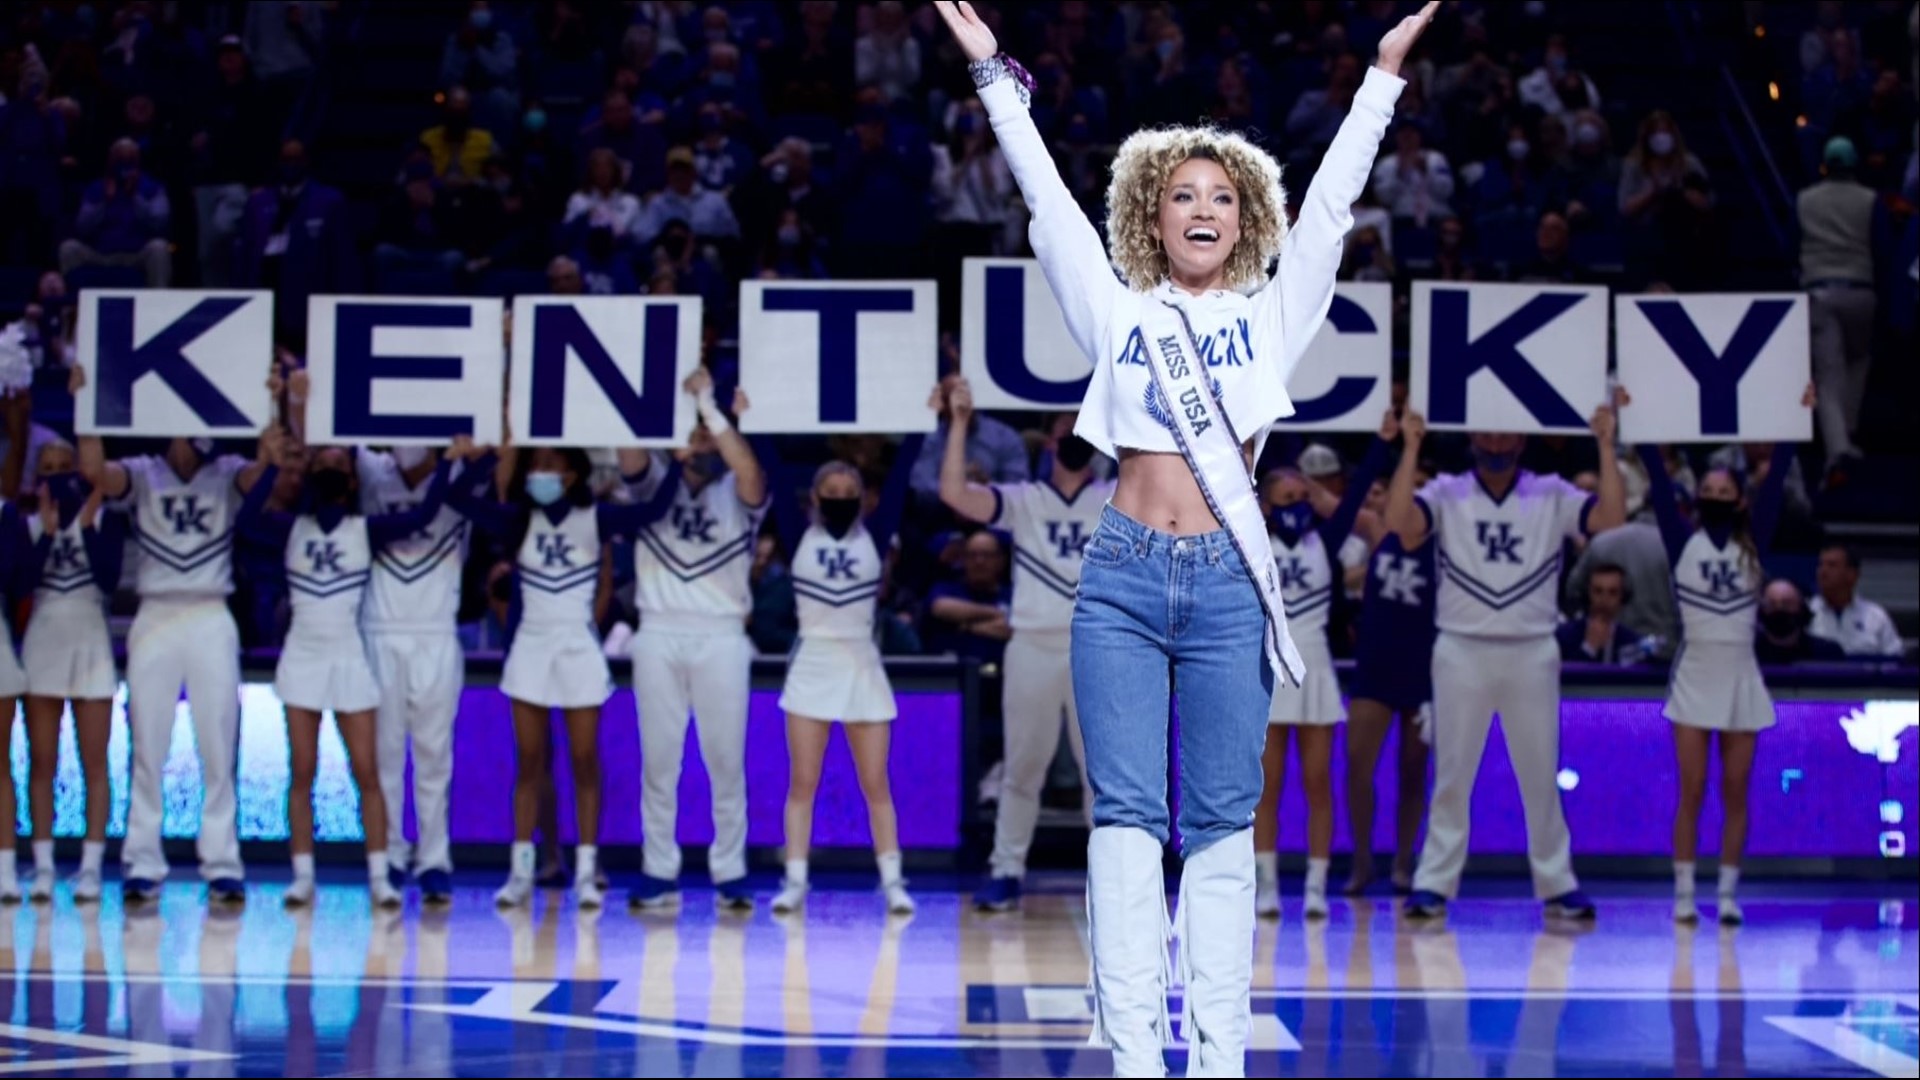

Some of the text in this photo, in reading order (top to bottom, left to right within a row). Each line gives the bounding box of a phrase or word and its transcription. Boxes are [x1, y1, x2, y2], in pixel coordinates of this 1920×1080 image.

[94, 297, 254, 428] K
[332, 302, 475, 437] E
[529, 303, 679, 438] N
[761, 287, 915, 424] T
[1157, 334, 1213, 437] MISS USA
[1426, 287, 1588, 428] K
[1634, 299, 1795, 436] Y
